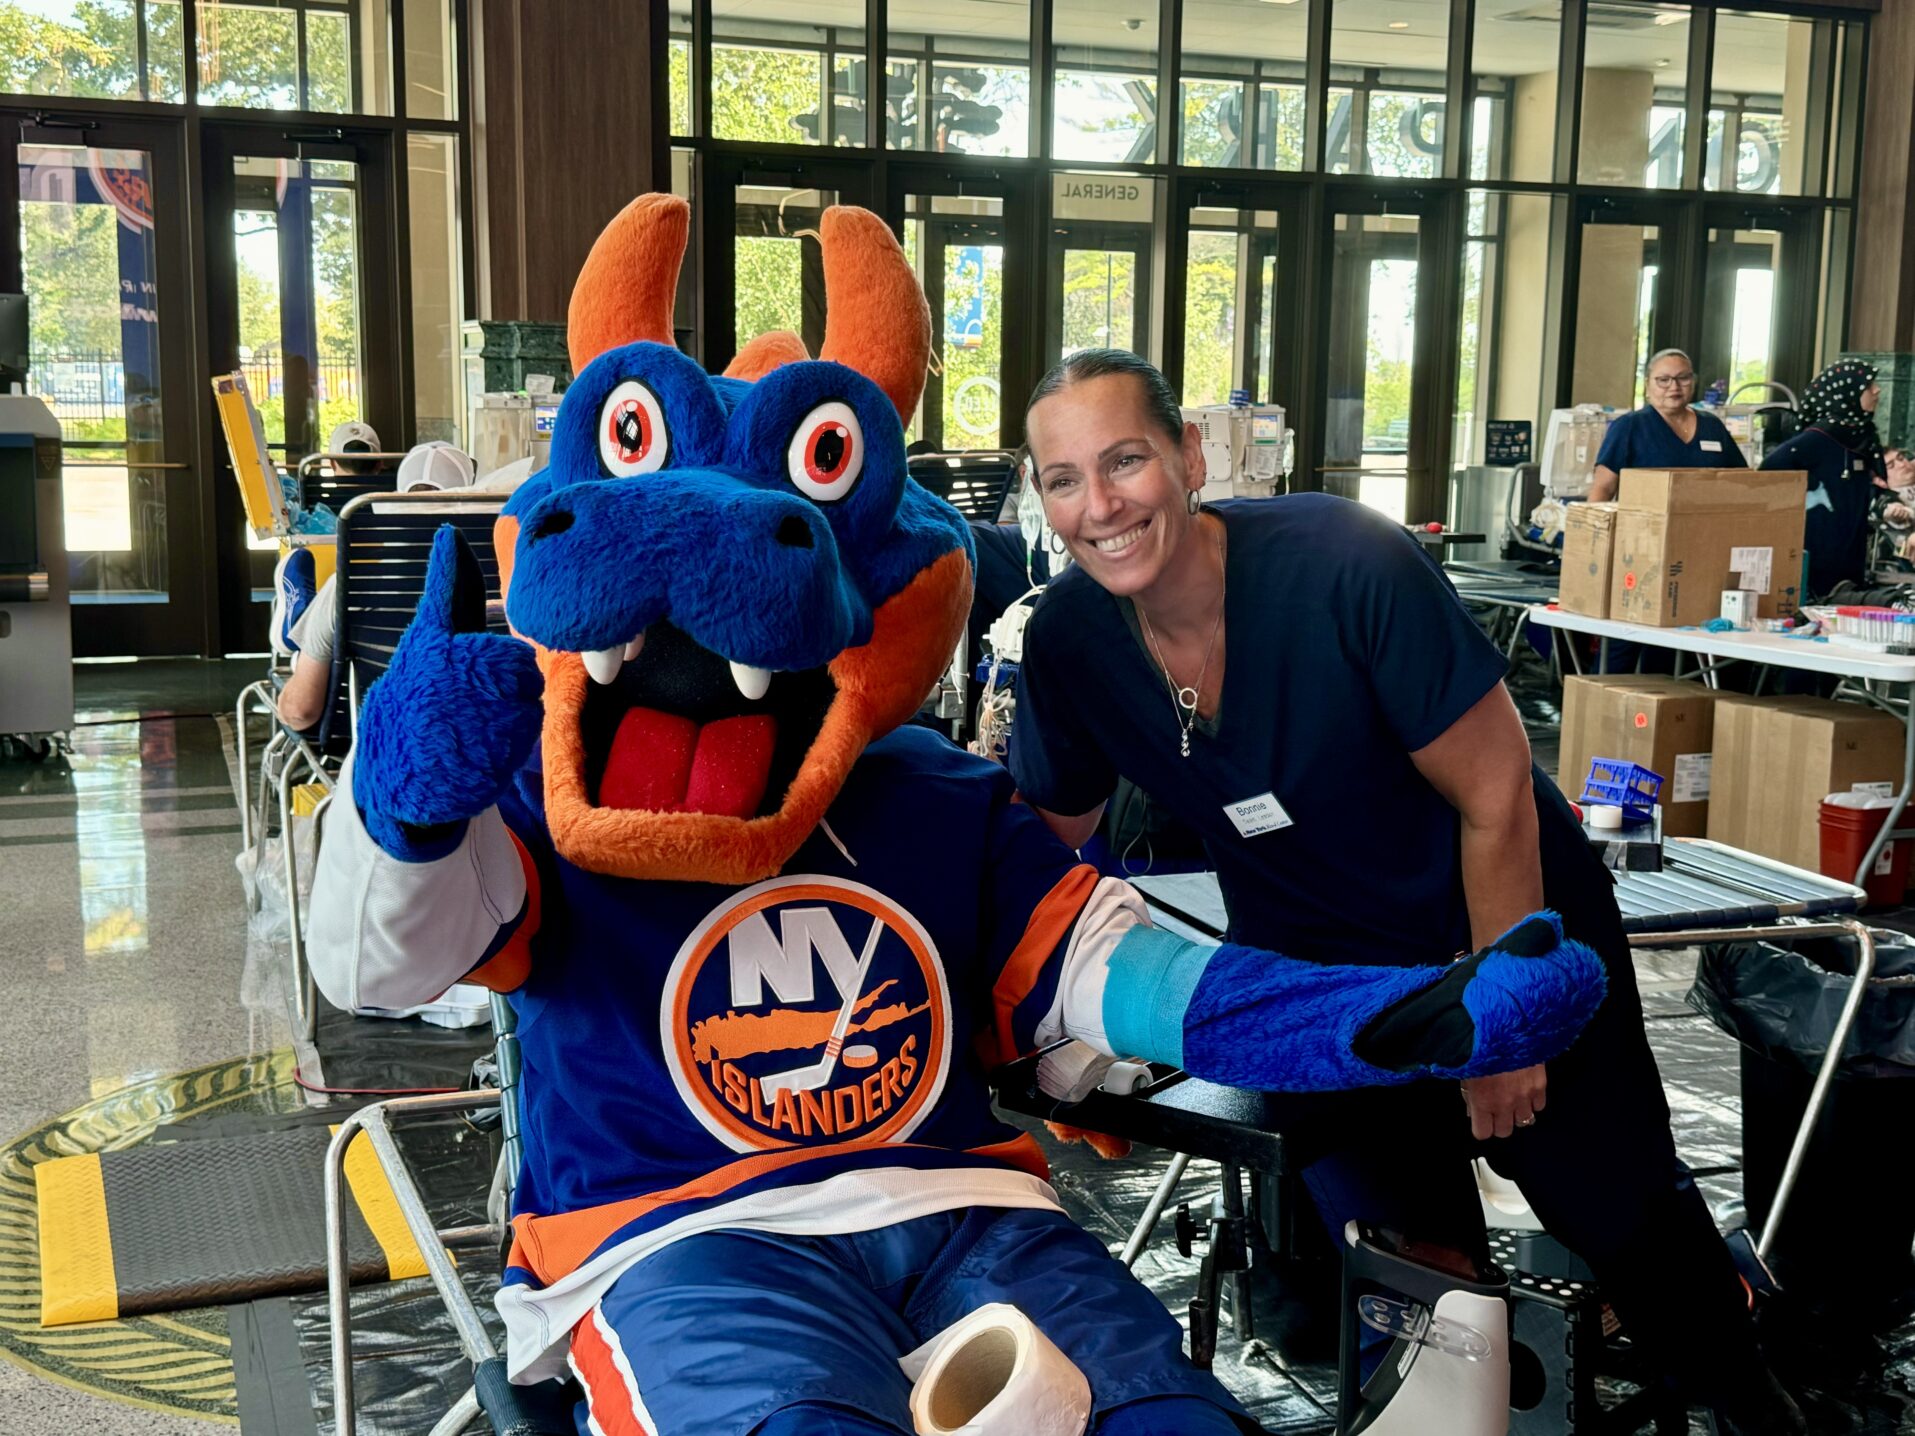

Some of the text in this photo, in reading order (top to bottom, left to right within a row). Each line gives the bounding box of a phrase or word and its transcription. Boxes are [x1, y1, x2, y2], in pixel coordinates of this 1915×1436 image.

[1235, 802, 1267, 817] Bonnie
[728, 907, 884, 1007] NY
[710, 1034, 918, 1136] ISLANDERS
